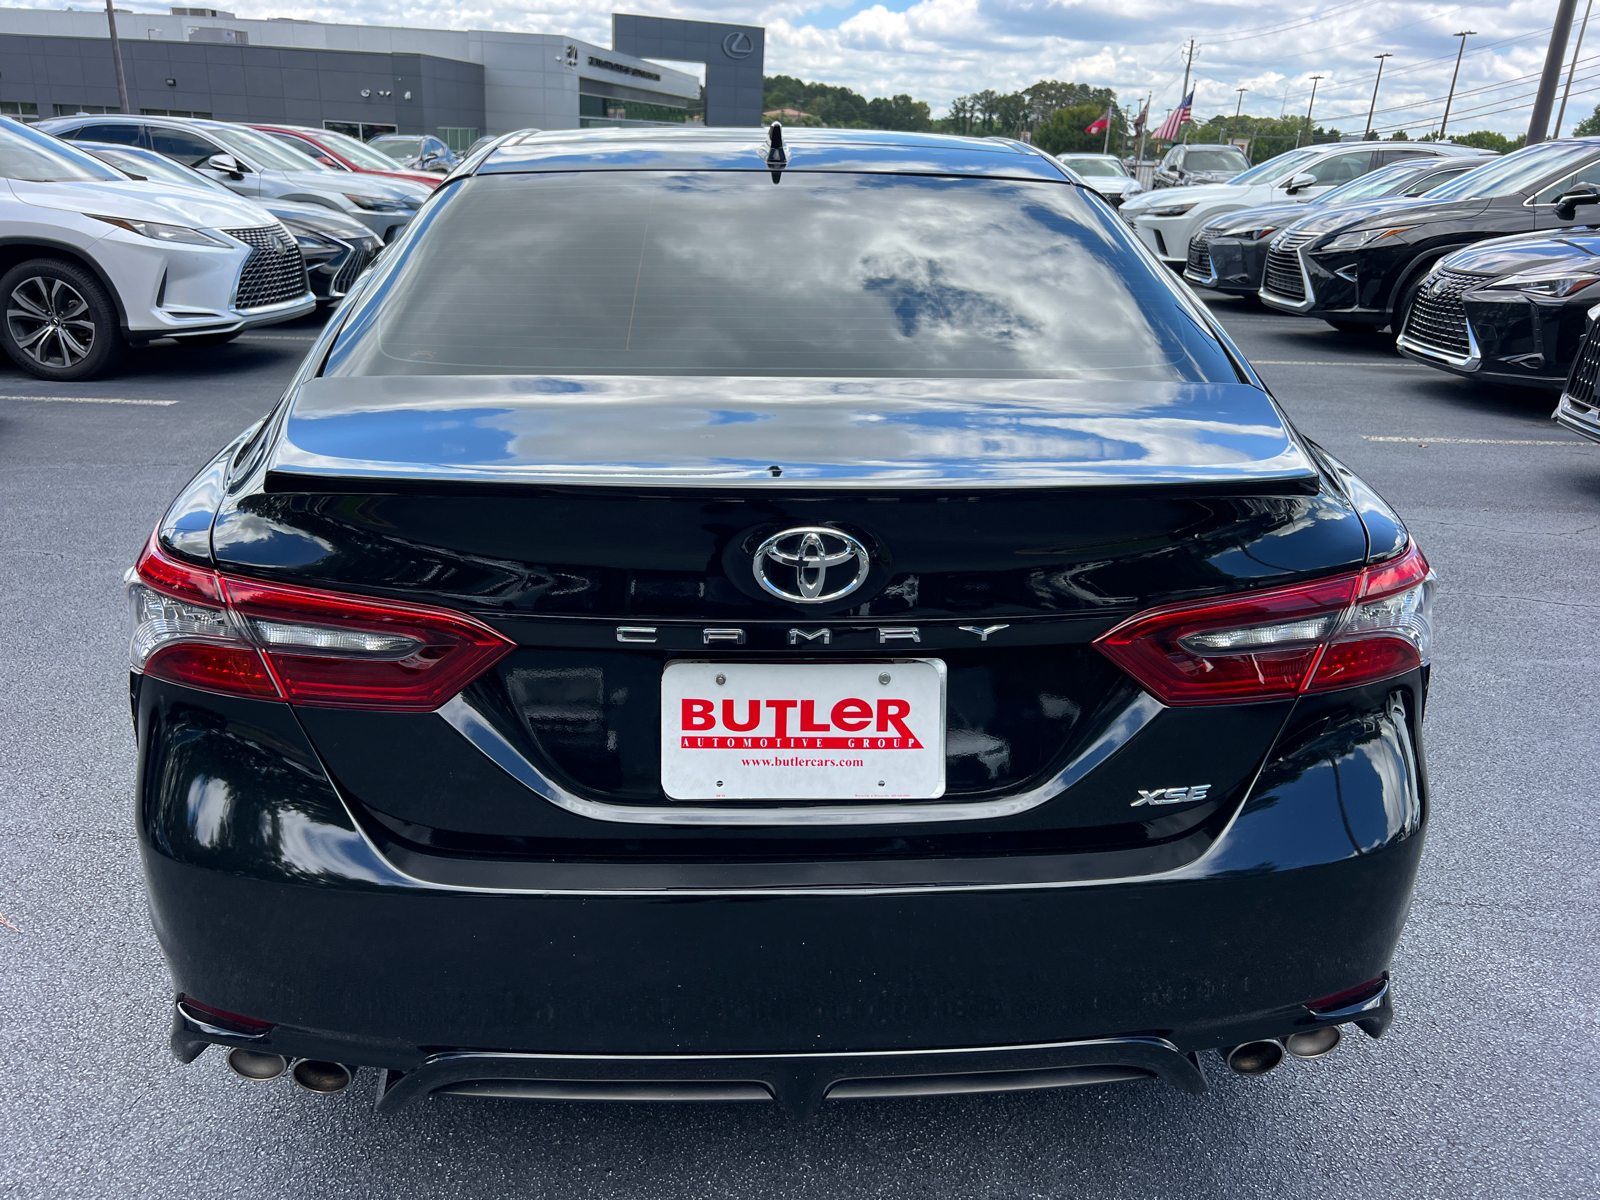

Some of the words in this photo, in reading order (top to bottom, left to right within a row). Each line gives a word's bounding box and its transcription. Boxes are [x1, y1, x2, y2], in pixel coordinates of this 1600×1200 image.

[616, 623, 1010, 645] CAMRY
[682, 737, 824, 749] AUTOMOTIVE
[847, 737, 915, 748] GROUP
[741, 757, 863, 768] www.butlercars.com
[1130, 784, 1212, 807] XSE
